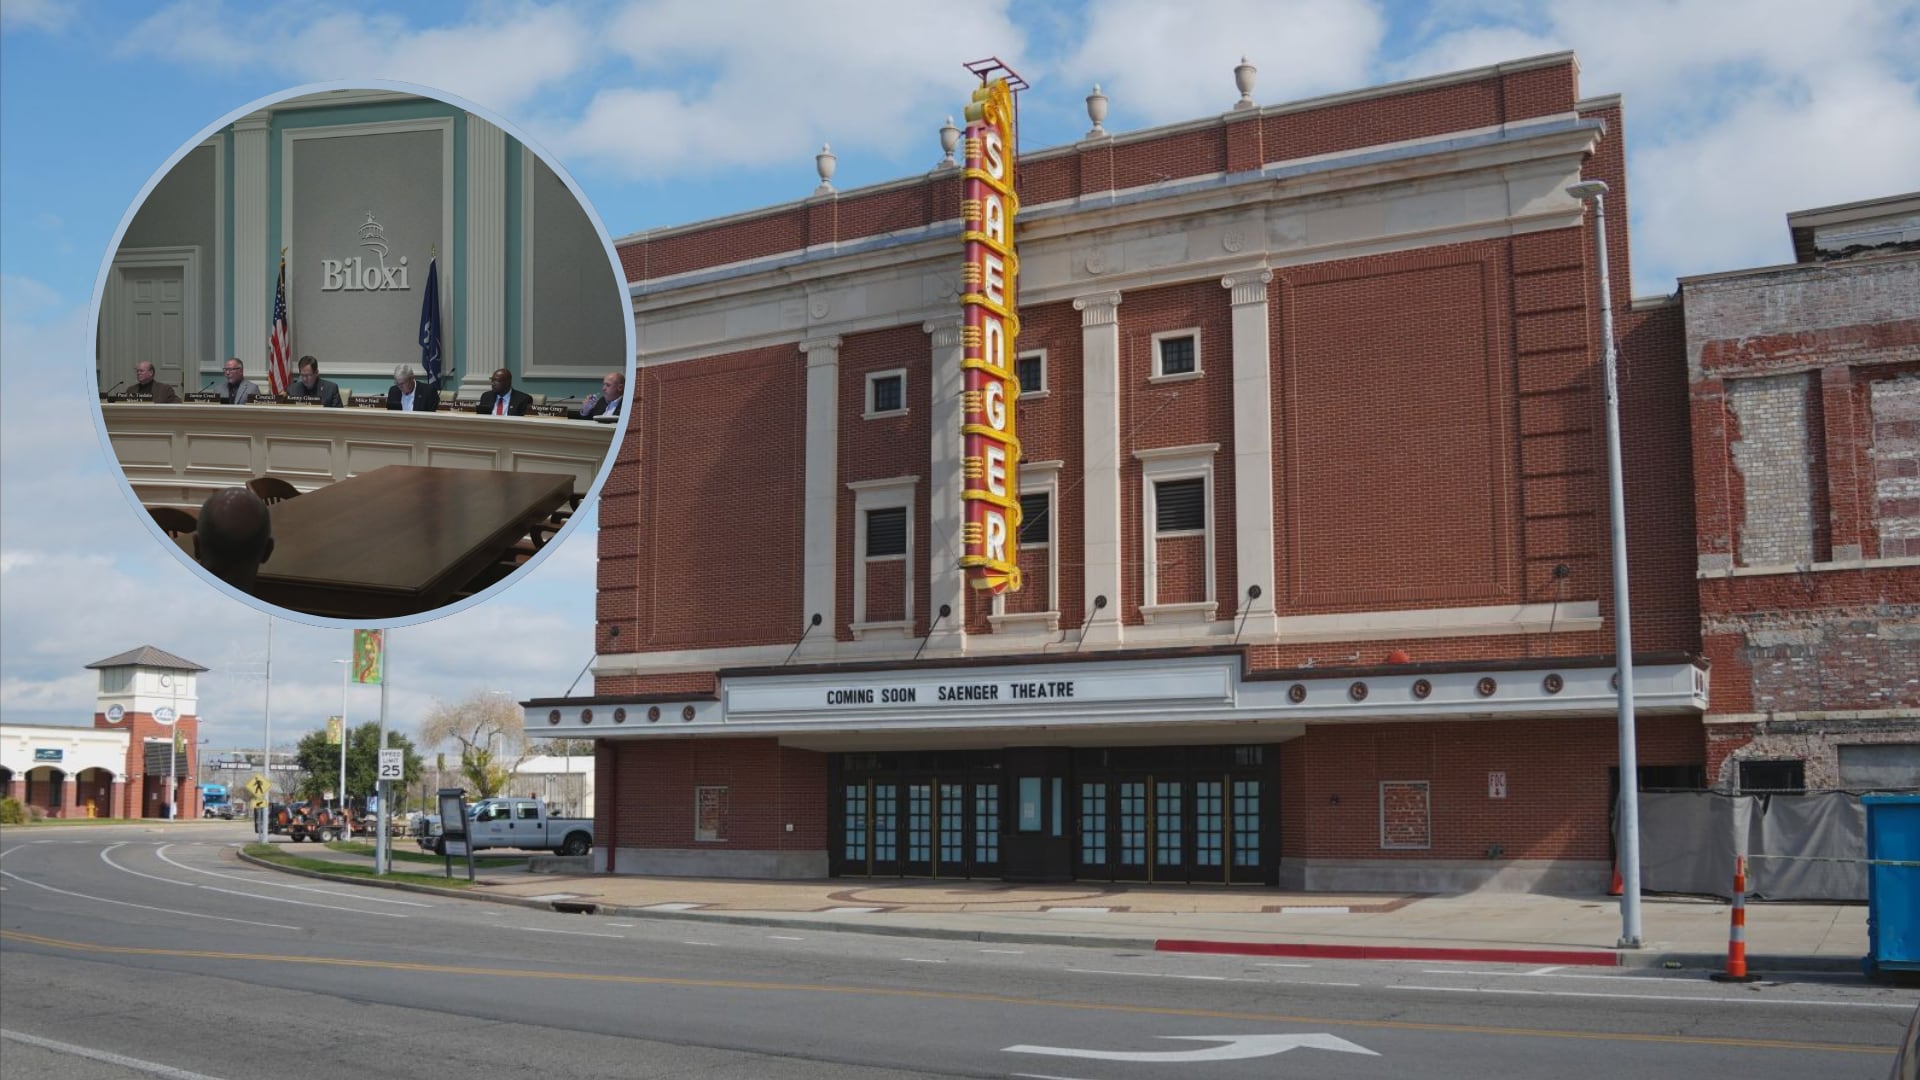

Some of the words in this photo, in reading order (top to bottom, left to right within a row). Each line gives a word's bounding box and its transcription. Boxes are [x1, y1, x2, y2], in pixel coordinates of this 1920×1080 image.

[321, 256, 410, 291] Biloxi
[984, 130, 1006, 563] SAENGER
[827, 689, 874, 704] COMING
[882, 687, 916, 703] SOON
[939, 684, 999, 701] SAENGER
[1010, 681, 1074, 699] THEATRE
[382, 765, 400, 776] 25
